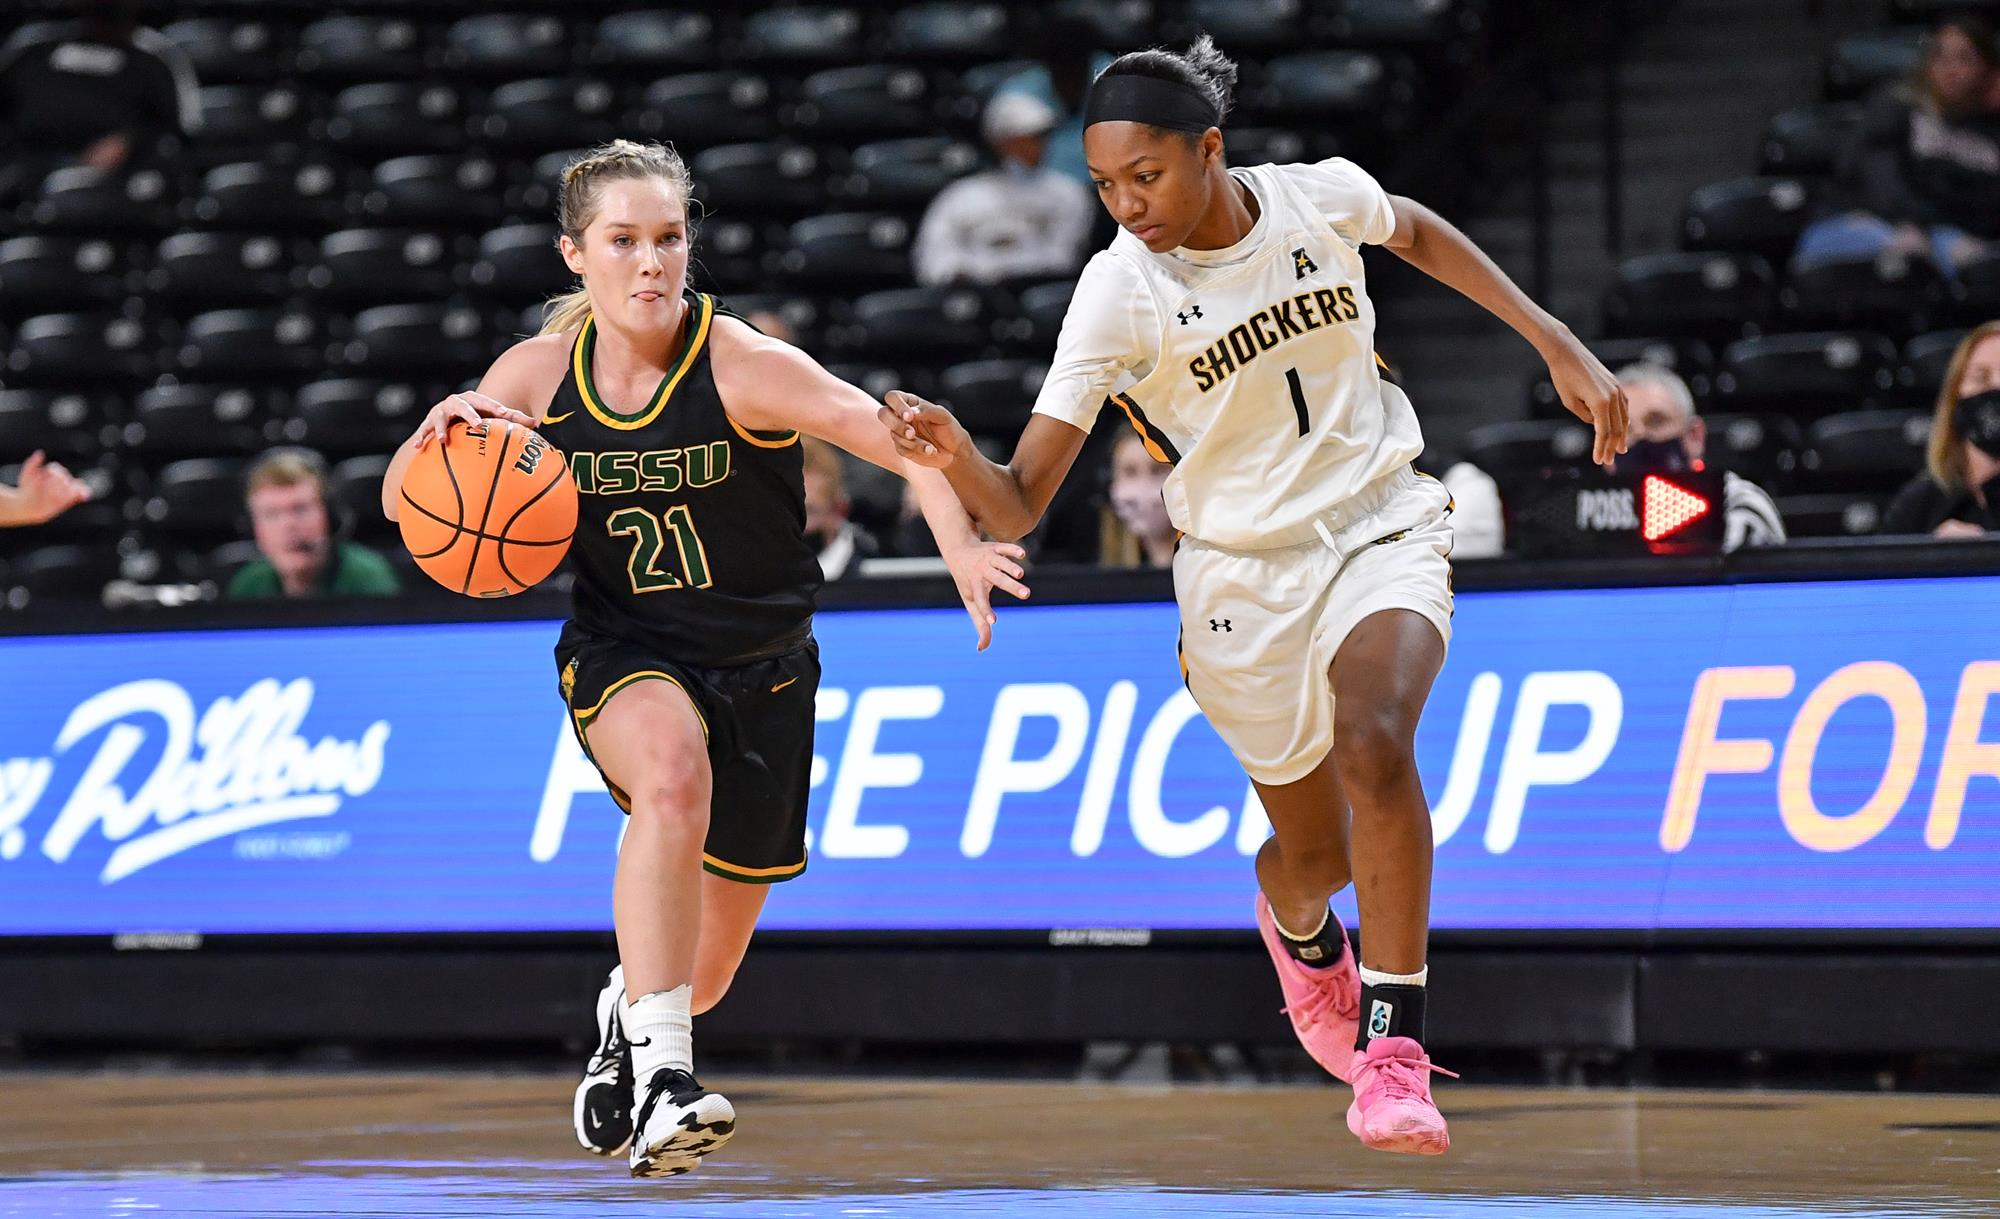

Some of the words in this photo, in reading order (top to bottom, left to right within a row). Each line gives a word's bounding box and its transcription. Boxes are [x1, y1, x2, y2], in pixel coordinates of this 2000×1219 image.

[1188, 286, 1360, 393] SHOCKERS
[1285, 367, 1310, 438] 1
[606, 504, 713, 594] 21
